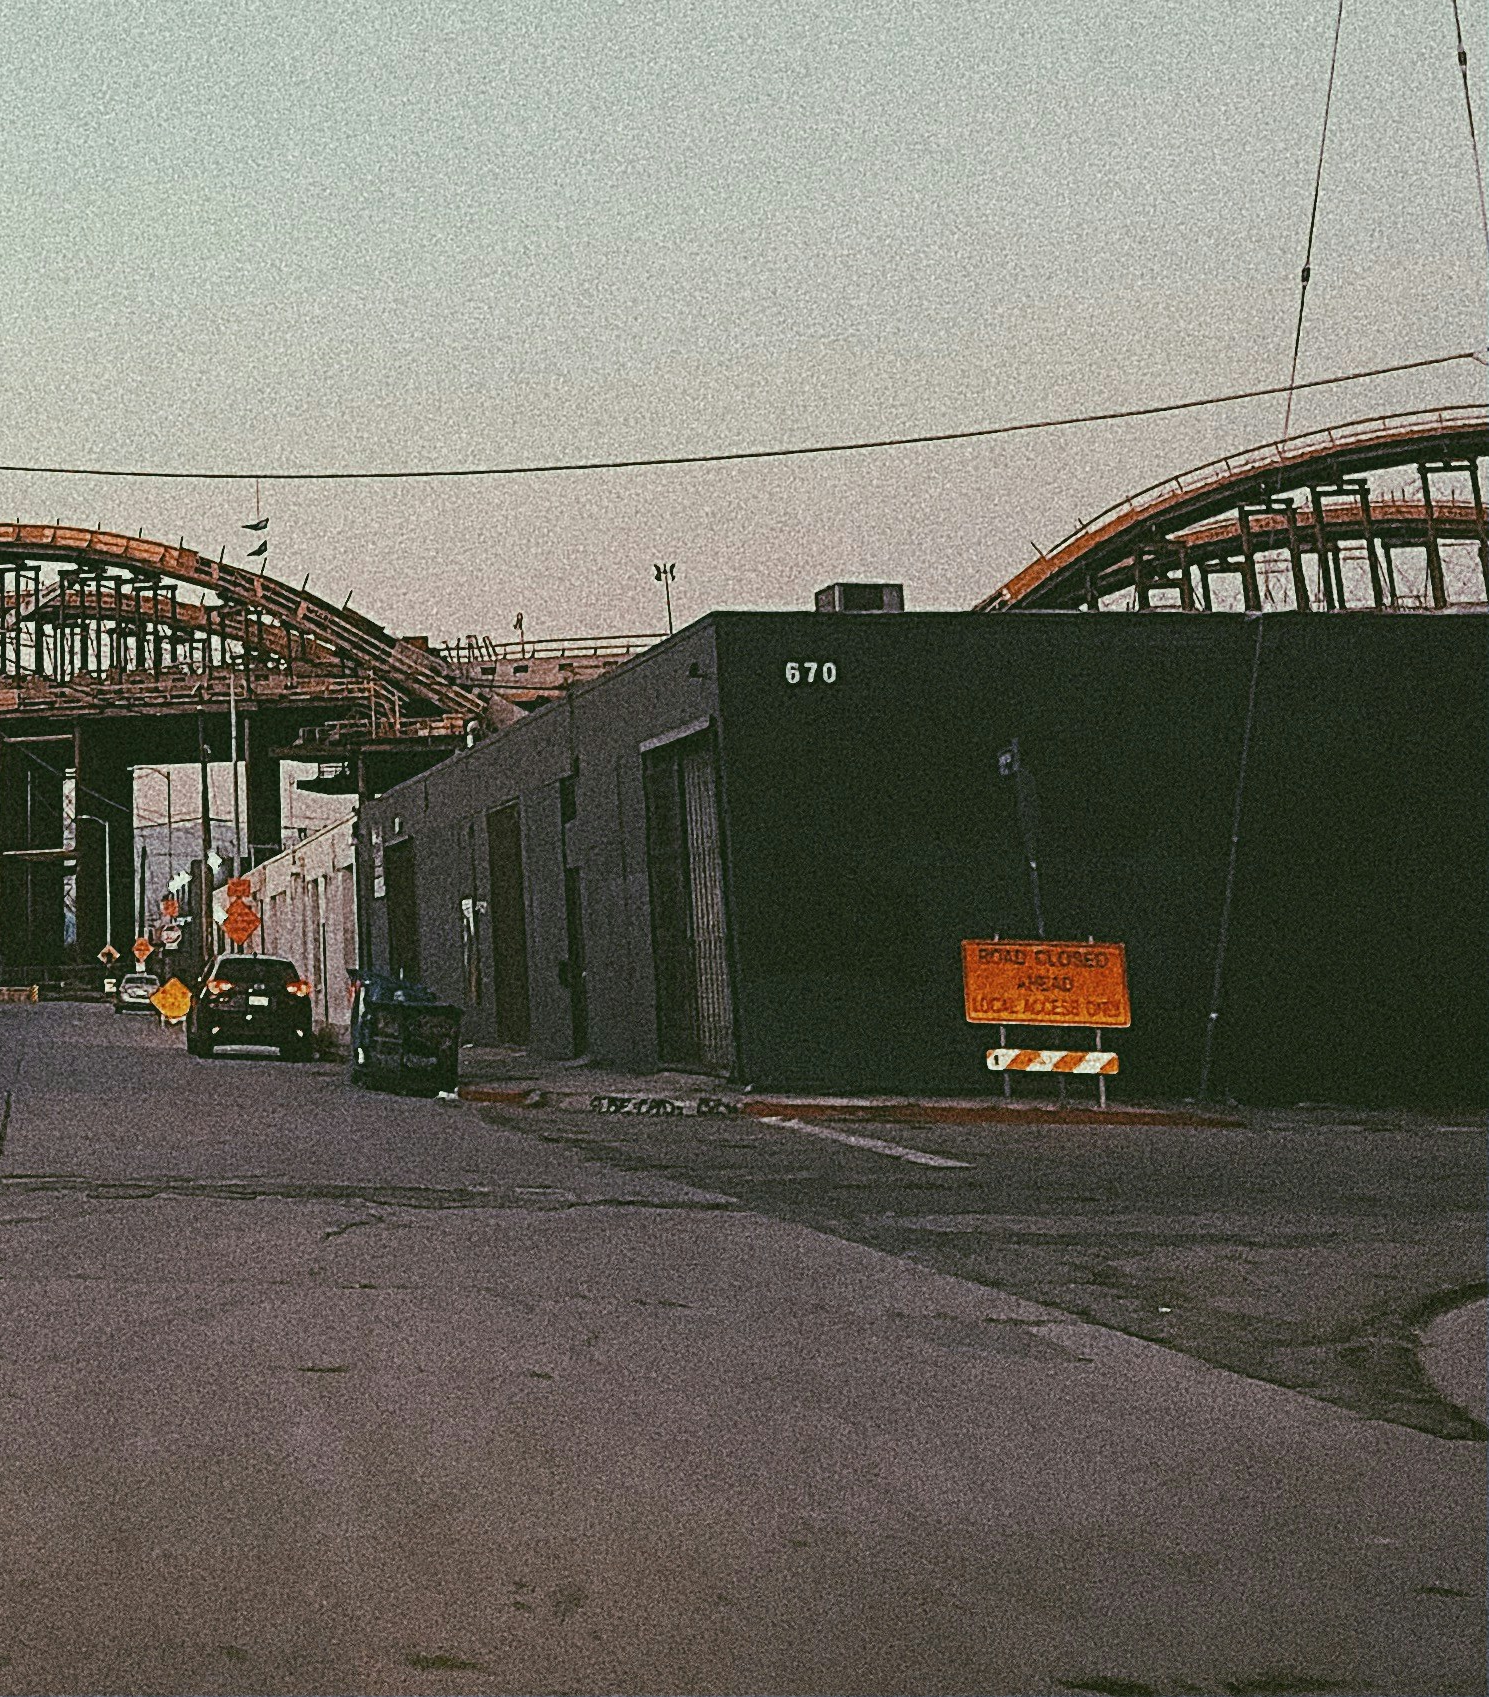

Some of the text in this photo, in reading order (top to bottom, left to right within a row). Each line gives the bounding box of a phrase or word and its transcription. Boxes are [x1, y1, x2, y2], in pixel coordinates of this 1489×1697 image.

[785, 661, 837, 684] 670
[977, 948, 1110, 969] ROAD CLOSED
[1016, 975, 1075, 993] AHEAD
[972, 996, 1020, 1014] LOCAL
[1023, 998, 1081, 1017] ACCESS
